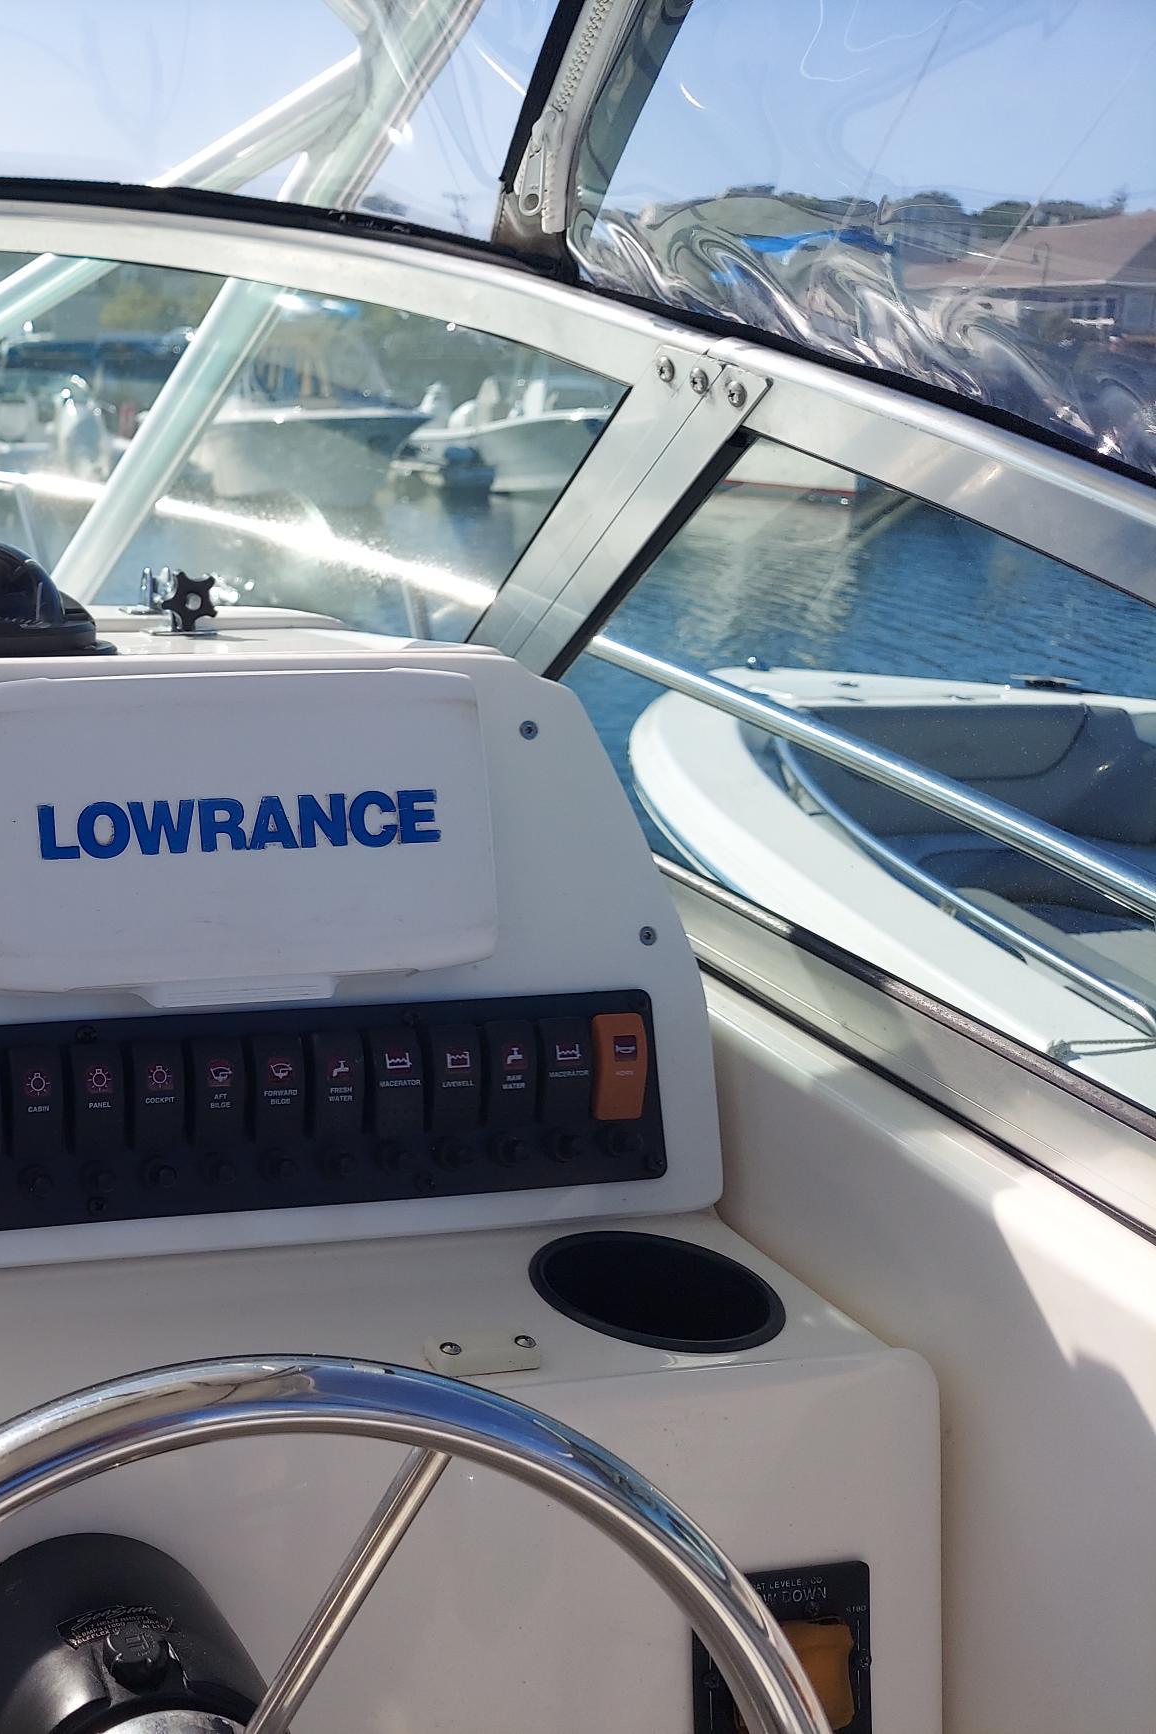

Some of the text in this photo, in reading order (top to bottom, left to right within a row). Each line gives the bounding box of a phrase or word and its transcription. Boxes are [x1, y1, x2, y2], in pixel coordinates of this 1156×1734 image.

[36, 788, 442, 860] LOWRANCE
[548, 1070, 589, 1078] MACERATOR
[379, 1079, 421, 1087] MACERATOR
[442, 1080, 474, 1088] LIVEWELL
[502, 1082, 525, 1090] WATER
[264, 1089, 298, 1097] FORWARD
[145, 1096, 175, 1104] COCKPIT
[27, 1105, 50, 1113] CABIN
[782, 1586, 827, 1602] DOWN
